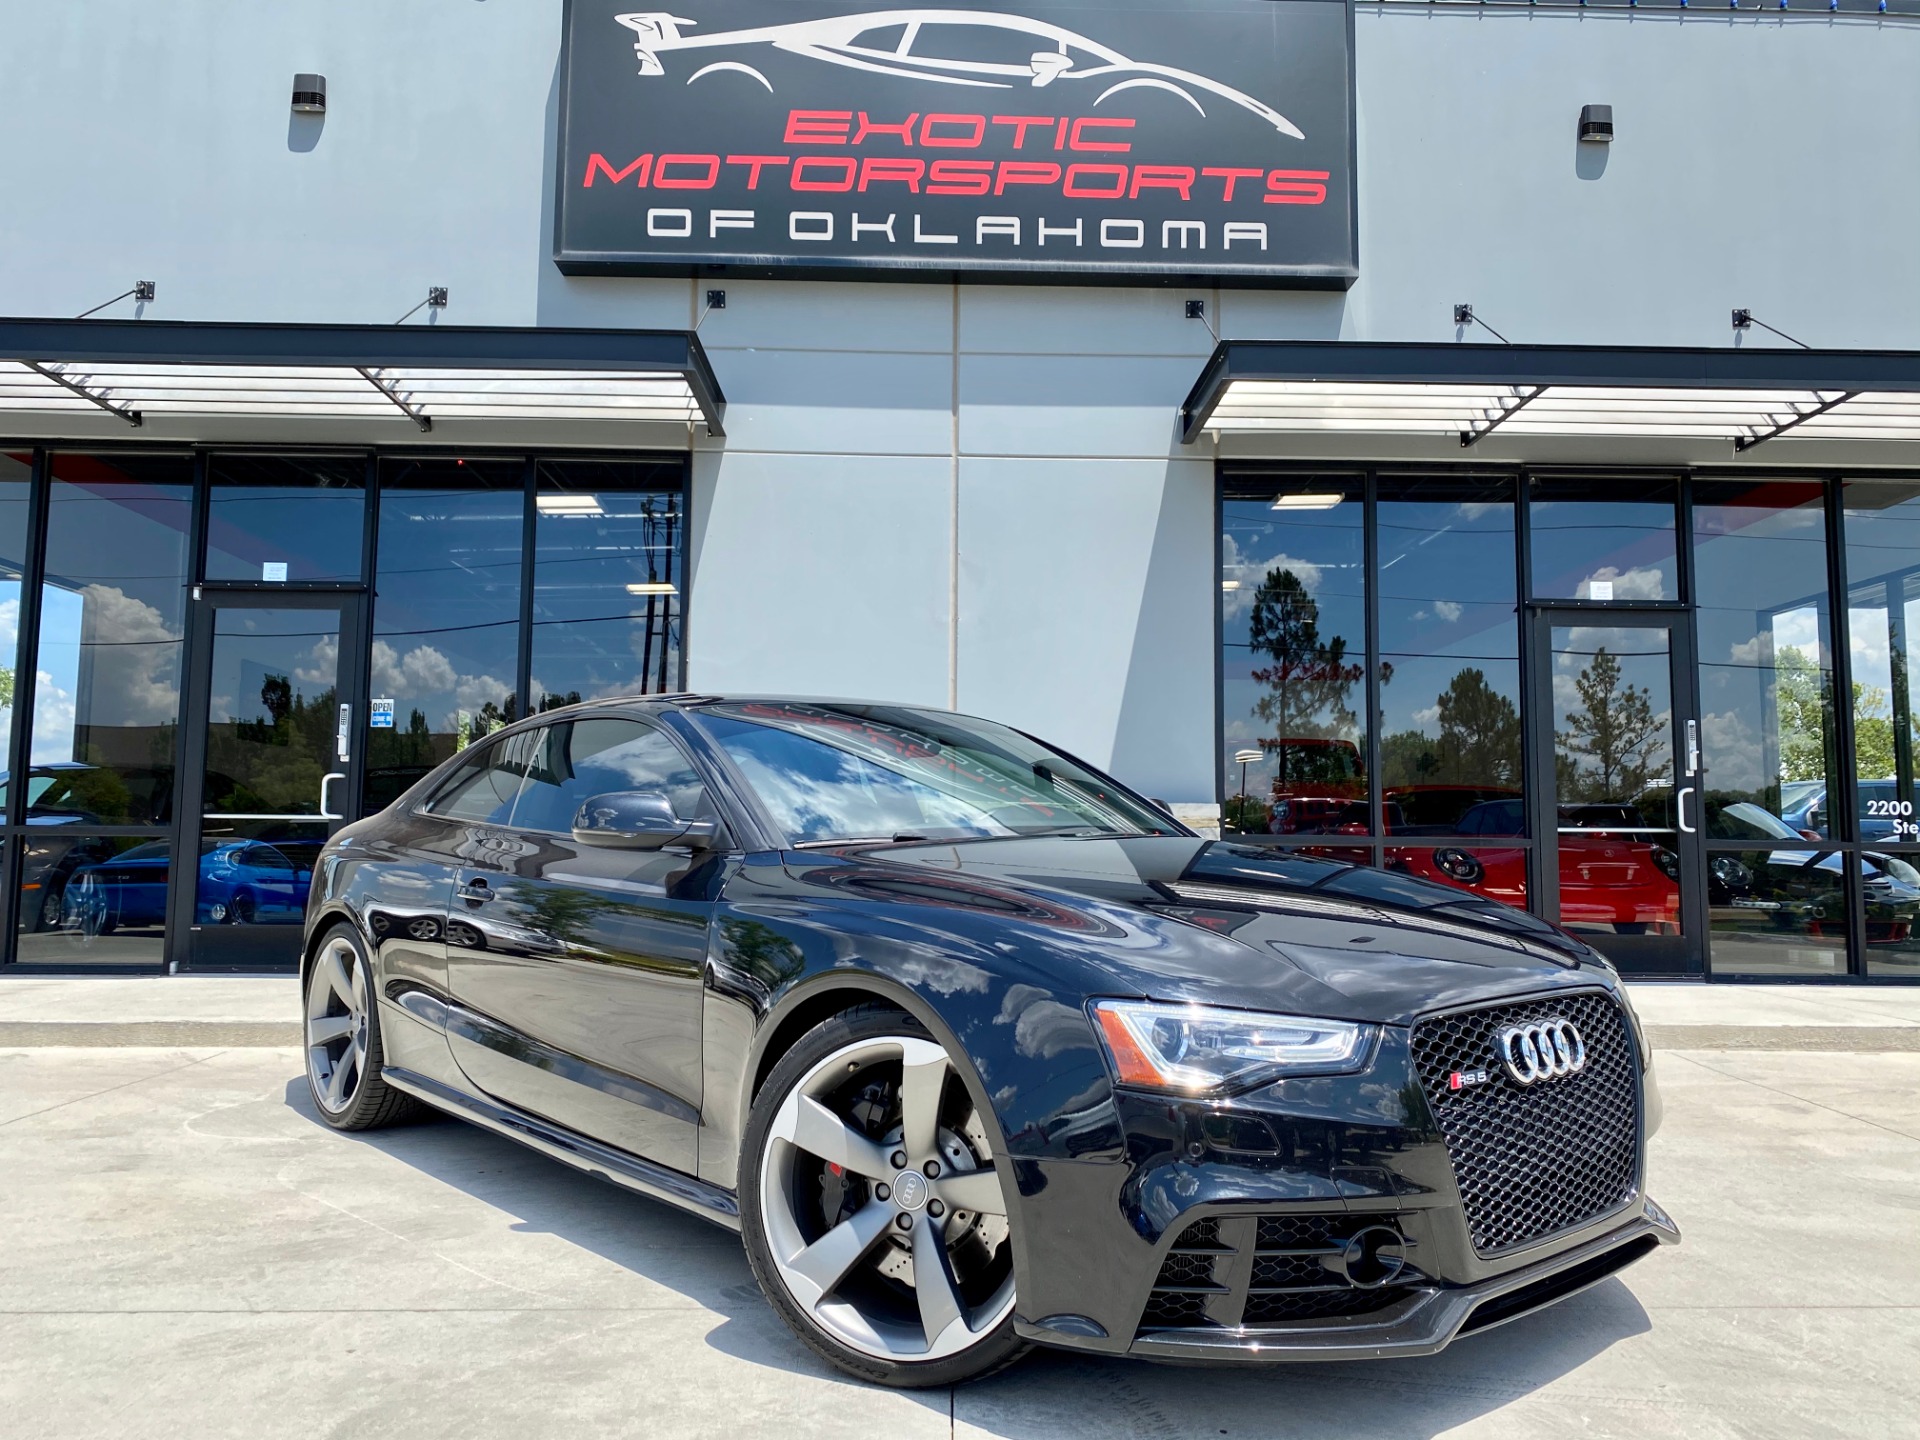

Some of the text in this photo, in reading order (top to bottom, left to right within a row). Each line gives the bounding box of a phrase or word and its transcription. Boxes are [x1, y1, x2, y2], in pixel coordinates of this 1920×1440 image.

[783, 109, 1136, 153] EXOTIC
[583, 153, 1330, 205] MOTORSPORTS
[646, 208, 1268, 251] OF OKLAHOMA
[372, 702, 393, 712] OPEN
[1866, 800, 1913, 816] 2200
[1892, 818, 1920, 834] Ste
